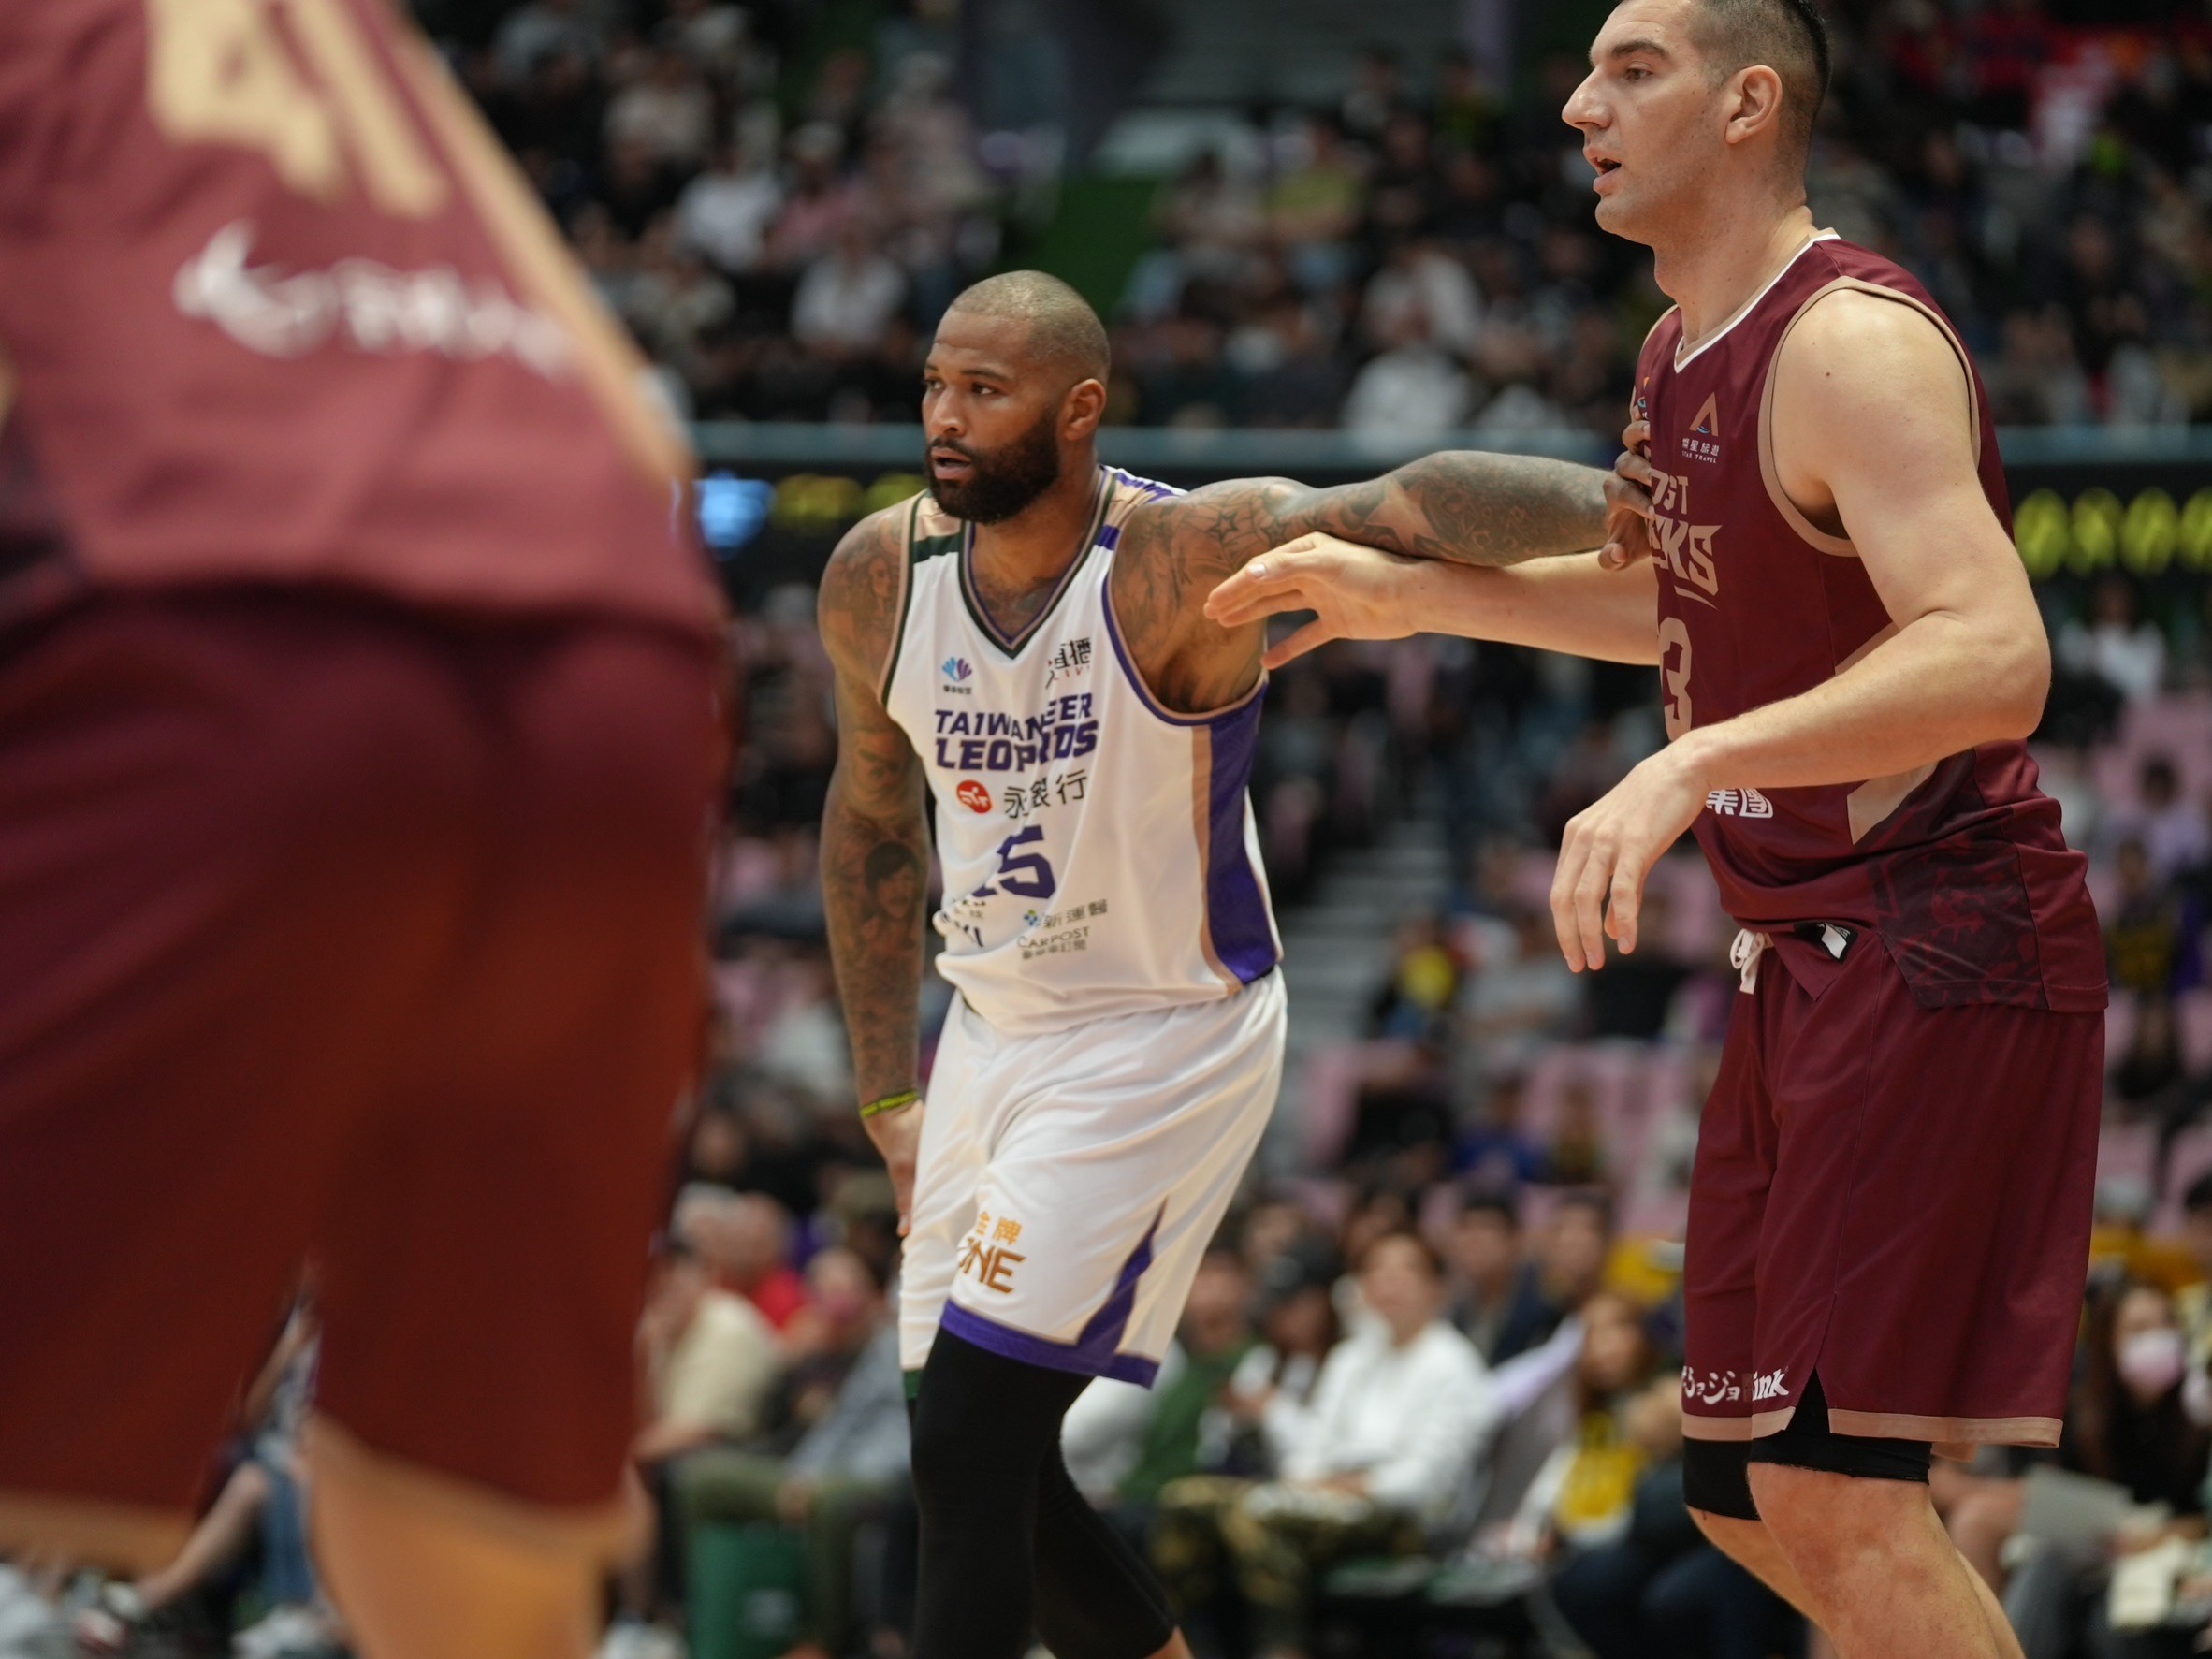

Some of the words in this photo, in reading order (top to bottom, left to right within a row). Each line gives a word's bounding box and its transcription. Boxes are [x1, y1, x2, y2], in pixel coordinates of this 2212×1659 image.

[1695, 454, 1716, 463] TRAVEL
[971, 824, 1055, 899] 5
[1017, 926, 1089, 948] CARPOST
